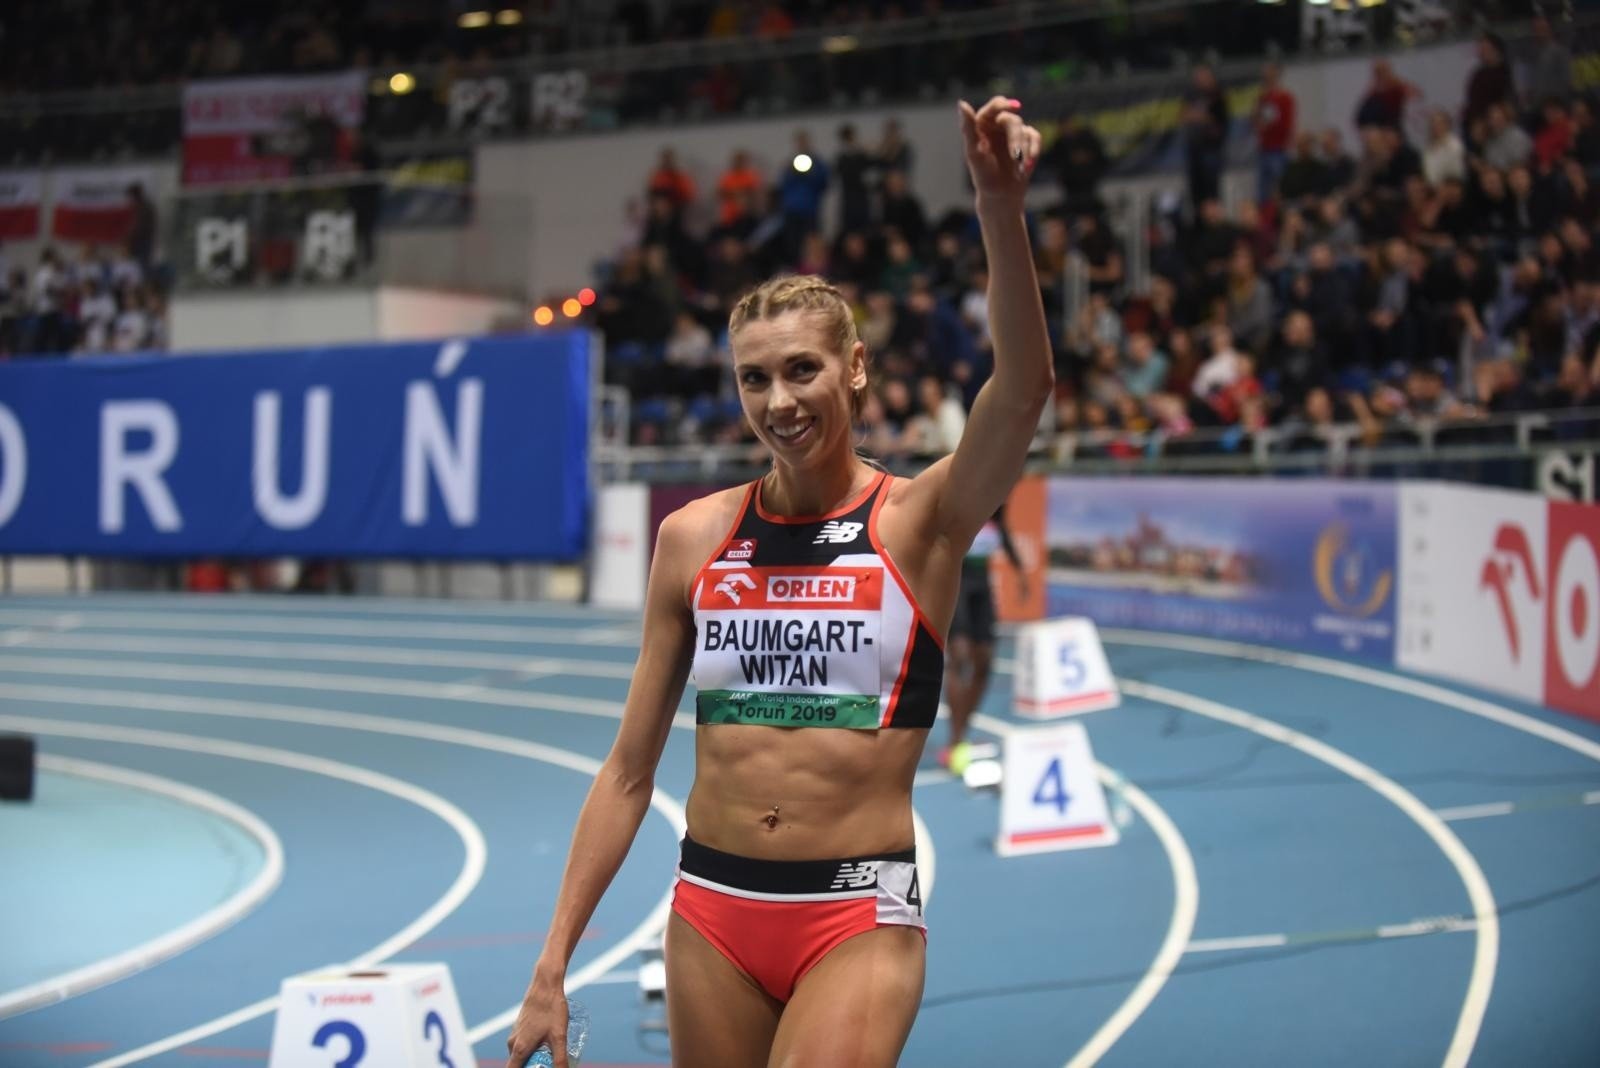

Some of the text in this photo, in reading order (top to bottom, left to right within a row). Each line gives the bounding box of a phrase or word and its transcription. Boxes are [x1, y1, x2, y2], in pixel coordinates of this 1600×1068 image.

[771, 579, 850, 599] ORLEN
[704, 619, 873, 653] BAUMGART-
[739, 654, 828, 687] WITAN
[1057, 640, 1087, 690] 5
[736, 701, 837, 722] Toruń 2019
[759, 693, 785, 704] World
[786, 694, 816, 705] Indoor
[818, 696, 841, 705] Tour
[1032, 757, 1073, 816] 4
